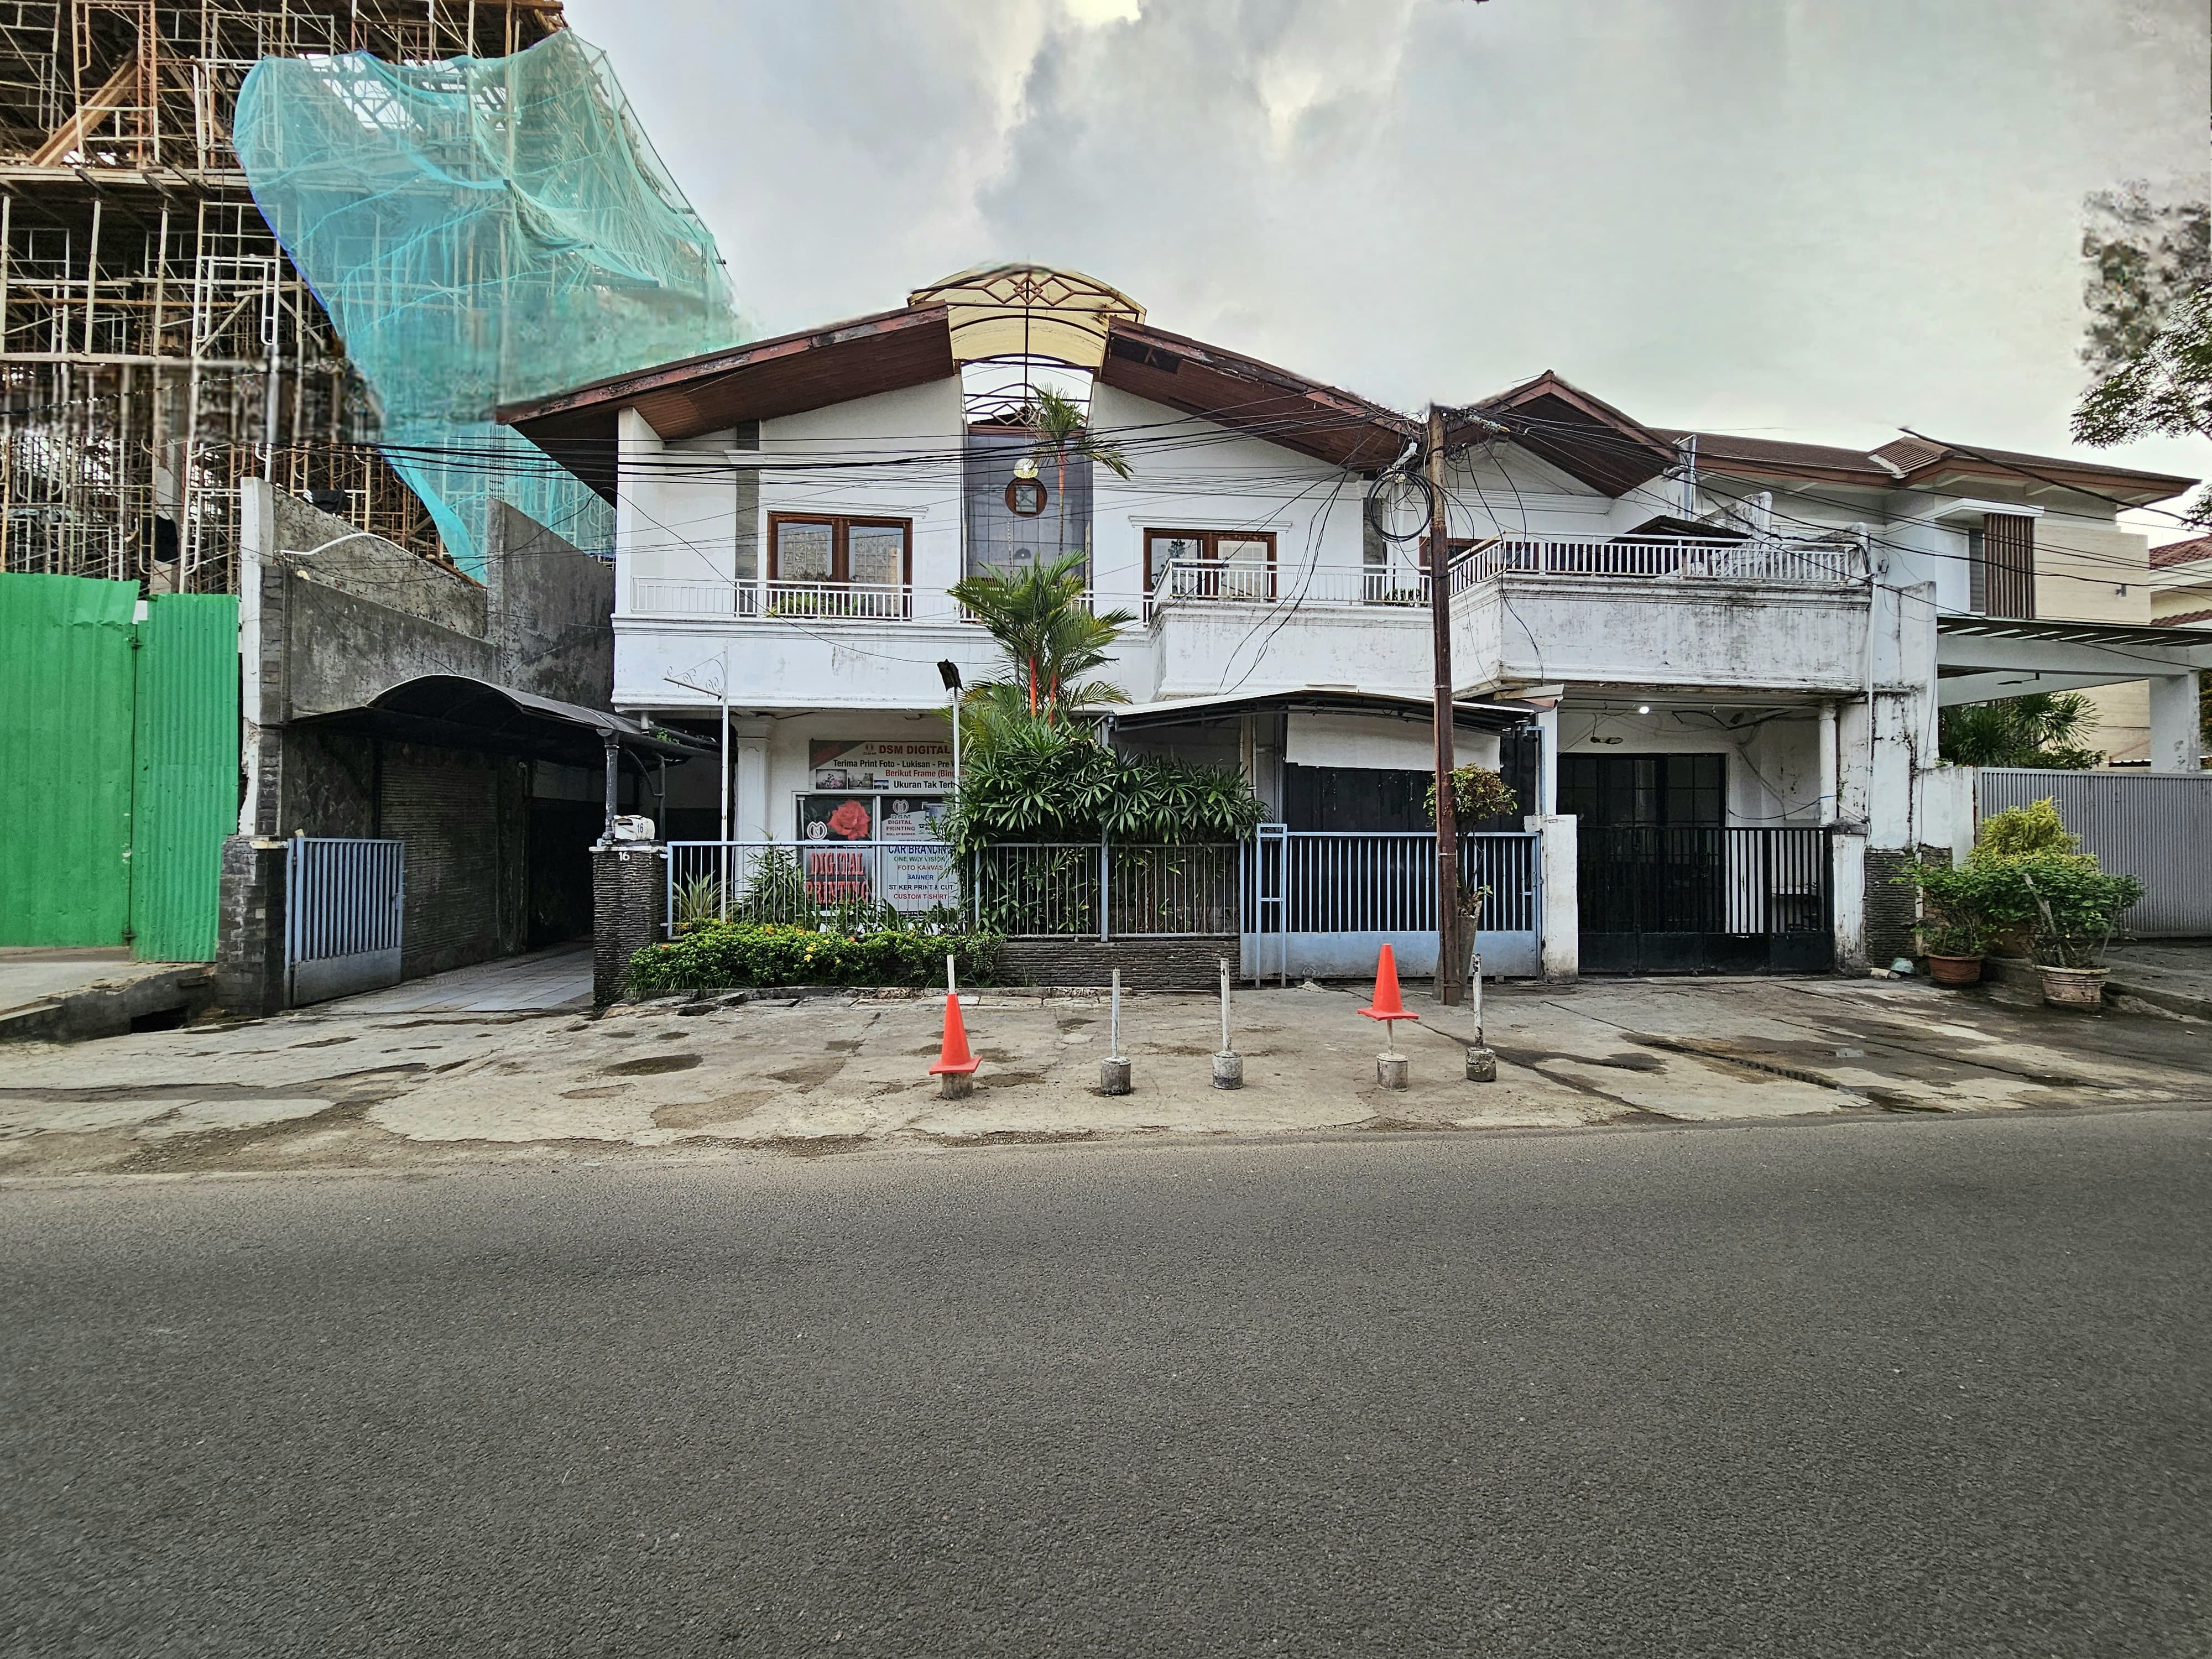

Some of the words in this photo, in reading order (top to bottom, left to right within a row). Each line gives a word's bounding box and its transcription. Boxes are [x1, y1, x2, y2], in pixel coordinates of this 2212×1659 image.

[879, 745, 903, 754] DSM
[907, 745, 951, 755] DIGITAL
[637, 823, 644, 833] 16
[888, 846, 906, 854] CAR
[619, 852, 630, 862] 16
[811, 852, 865, 875] DIGITAL
[806, 880, 869, 904] PRINTING
